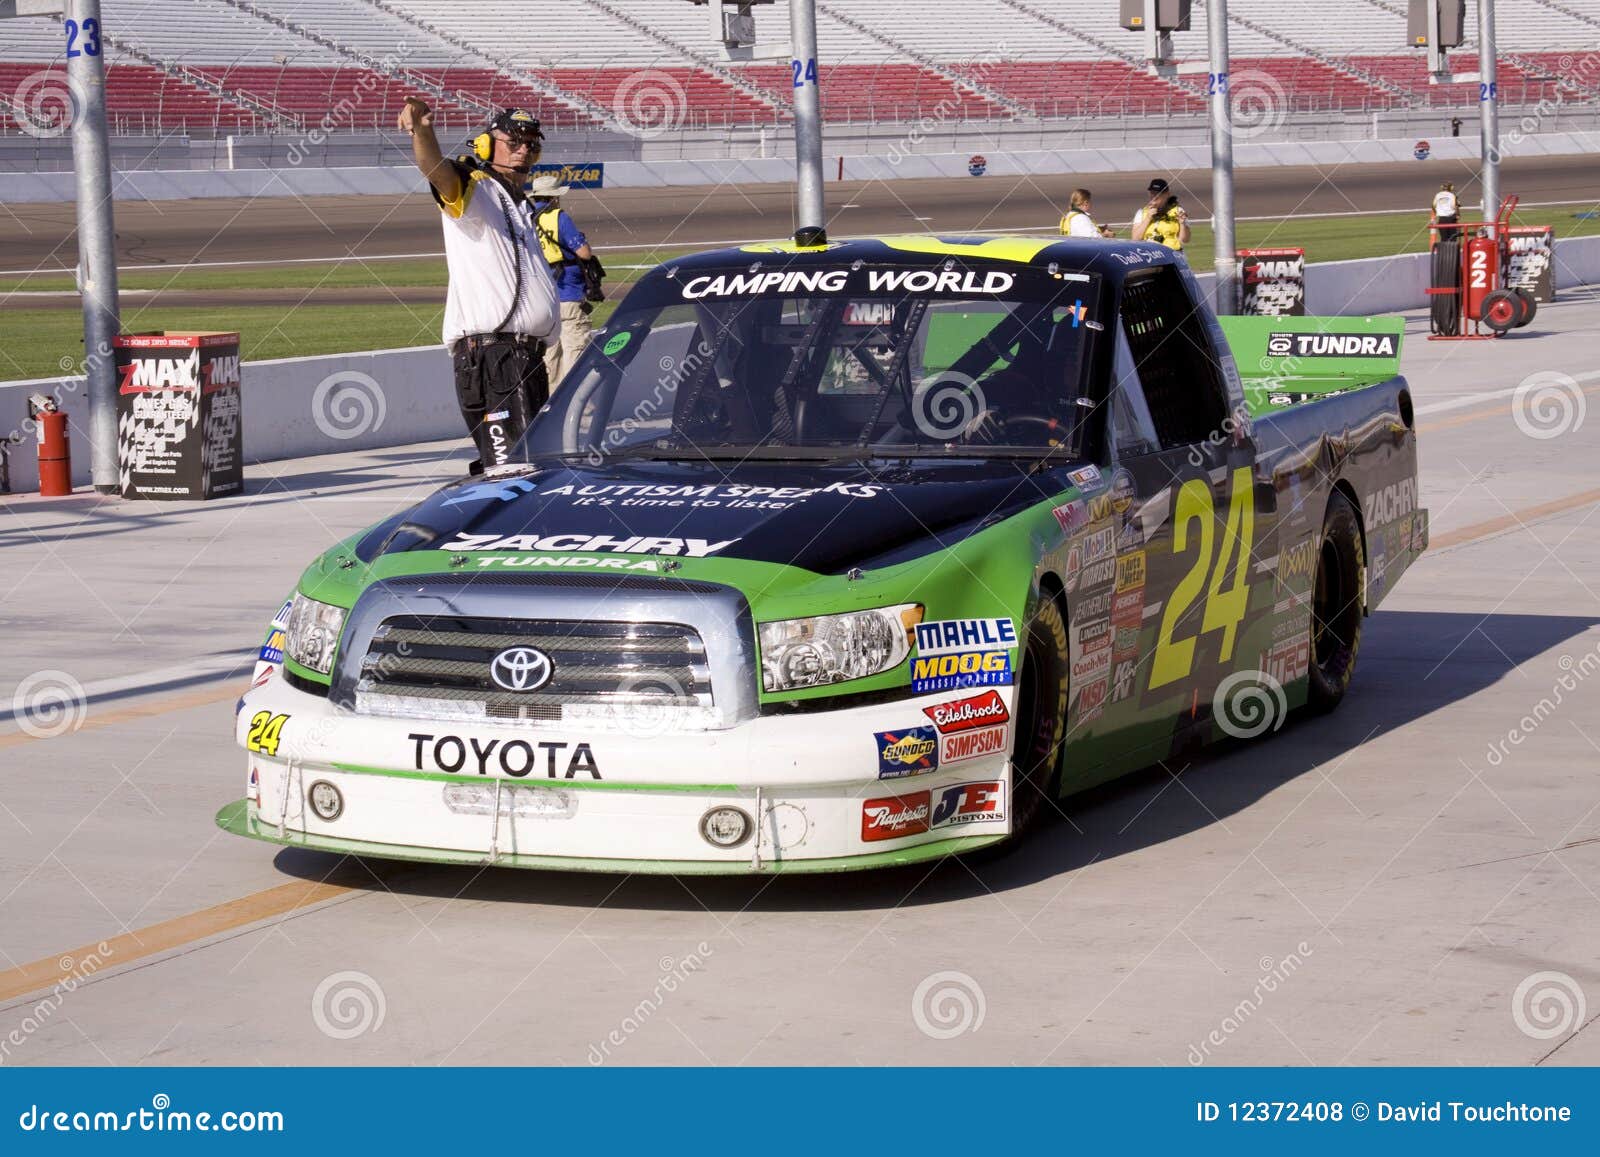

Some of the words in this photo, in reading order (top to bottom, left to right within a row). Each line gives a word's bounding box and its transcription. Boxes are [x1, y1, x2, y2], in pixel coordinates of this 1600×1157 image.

[65, 18, 99, 58] 23
[792, 58, 817, 88] 24
[1209, 74, 1228, 95] 25
[682, 270, 849, 299] CAMPING
[869, 270, 1016, 294] WORLD
[1297, 336, 1393, 355] TUNDRA
[489, 425, 508, 464] CAM
[540, 485, 716, 496] AUTISM
[718, 482, 886, 498] SPEAKS
[620, 497, 675, 508] time
[691, 498, 720, 507] to
[440, 532, 742, 557] ZACHRY
[476, 556, 658, 572] TUNDRA
[1149, 466, 1254, 690] 24
[917, 619, 1016, 650] MAHLE
[913, 652, 1007, 680] MOOG
[917, 676, 960, 691] CHASSIS
[967, 672, 1005, 684] PARTS
[934, 698, 1004, 726] Edelbrock
[248, 711, 291, 757] 24
[945, 728, 1004, 760] SIMPSON
[408, 733, 602, 781] TOYOTA
[886, 741, 933, 758] SUNOCO
[932, 783, 999, 825] JE
[950, 812, 1004, 823] PISTONS
